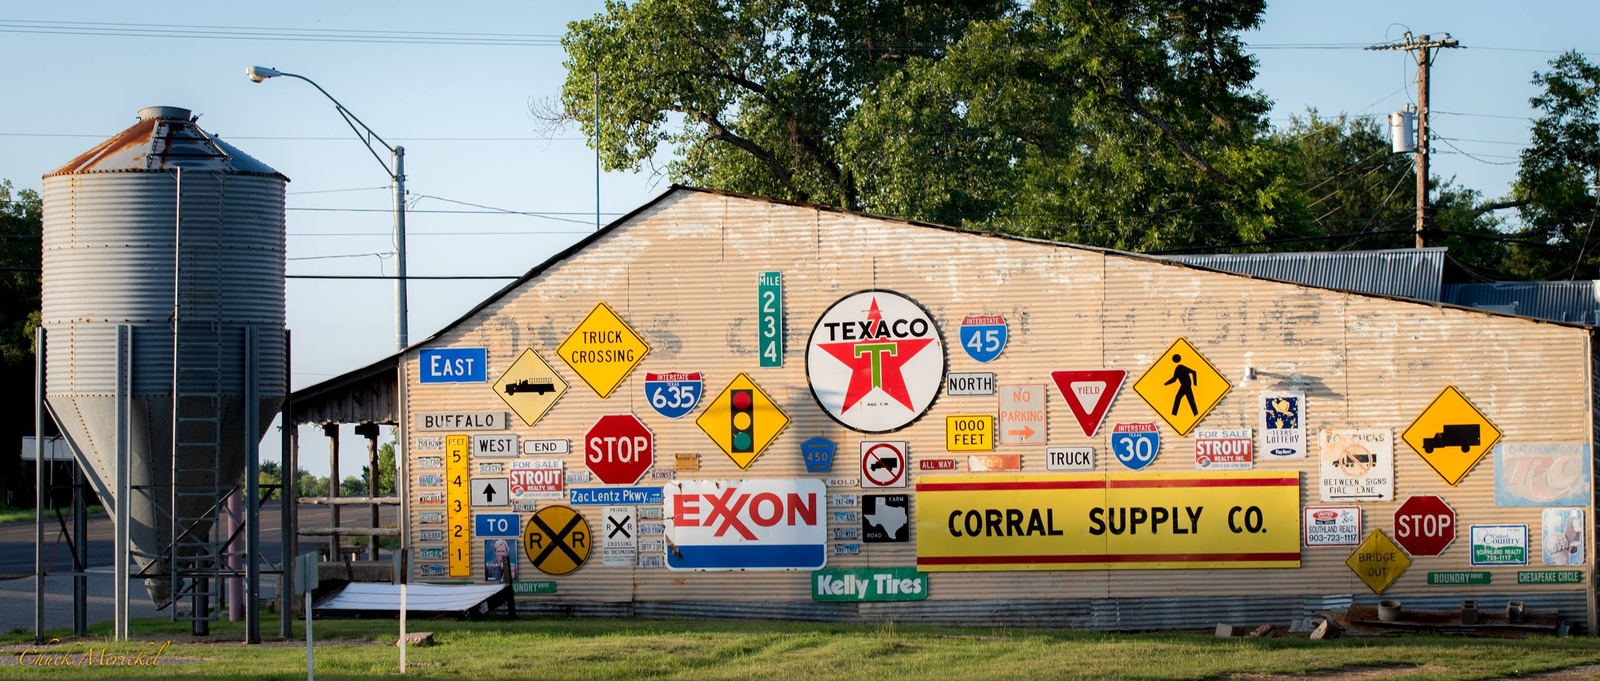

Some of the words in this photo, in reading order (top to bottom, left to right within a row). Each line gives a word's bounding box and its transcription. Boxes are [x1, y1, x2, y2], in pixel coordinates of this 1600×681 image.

[759, 276, 780, 286] MILE
[824, 318, 929, 341] TEXACO
[582, 331, 623, 343] TRUCK
[967, 330, 1000, 352] 45
[572, 350, 635, 363] CROSSING
[431, 355, 474, 377] EAST
[854, 342, 898, 390] T
[949, 377, 992, 391] NORTH
[1077, 386, 1100, 394] YIELD
[653, 386, 695, 408] 635
[1013, 391, 1031, 402] NO
[425, 414, 494, 428] BUFFALO
[1001, 411, 1043, 422] PARKING
[954, 420, 985, 431] 1000
[1118, 424, 1152, 432] INTERSTATE
[954, 434, 985, 445] FEET
[1222, 430, 1248, 438] SALE
[1266, 435, 1299, 443] LOTTERY
[1346, 433, 1385, 442] UCKS
[479, 439, 512, 452] WEST
[534, 443, 558, 452] END
[589, 436, 648, 463] STOP
[1119, 437, 1152, 461] 30
[1197, 440, 1250, 456] STROUT
[453, 450, 461, 463] 5
[808, 452, 828, 462] 450
[1050, 452, 1090, 466] TRUCK
[938, 460, 952, 468] WAY
[453, 475, 462, 488] 4
[511, 470, 561, 485] STROUT
[571, 491, 589, 502] Zac
[591, 490, 620, 502] Lentz
[623, 490, 649, 504] Pkwy.
[453, 500, 462, 513] 3
[673, 487, 818, 541] EXXON
[486, 518, 509, 533] TO
[948, 508, 1064, 537] CORRAL
[1089, 506, 1204, 536] SUPPLY
[1228, 505, 1267, 534] CO.
[1398, 514, 1451, 537] STOP
[454, 525, 463, 538] 2
[1309, 525, 1338, 533] SOUTHLAND
[1339, 525, 1357, 533] REALTY
[530, 532, 542, 549] R
[572, 531, 585, 548] R
[1309, 534, 1357, 542] 903-723-1117
[1483, 534, 1520, 546] Country
[457, 548, 462, 561] 1
[1358, 552, 1396, 563] BRIDGE
[1368, 567, 1388, 577] OUT
[1434, 573, 1469, 583] BOUNDRY
[1519, 572, 1557, 582] CHESAPEAKE
[1558, 571, 1579, 581] CIRCLE
[512, 582, 538, 592] UNDRY
[817, 574, 869, 599] Kelly
[873, 573, 922, 596] Tires
